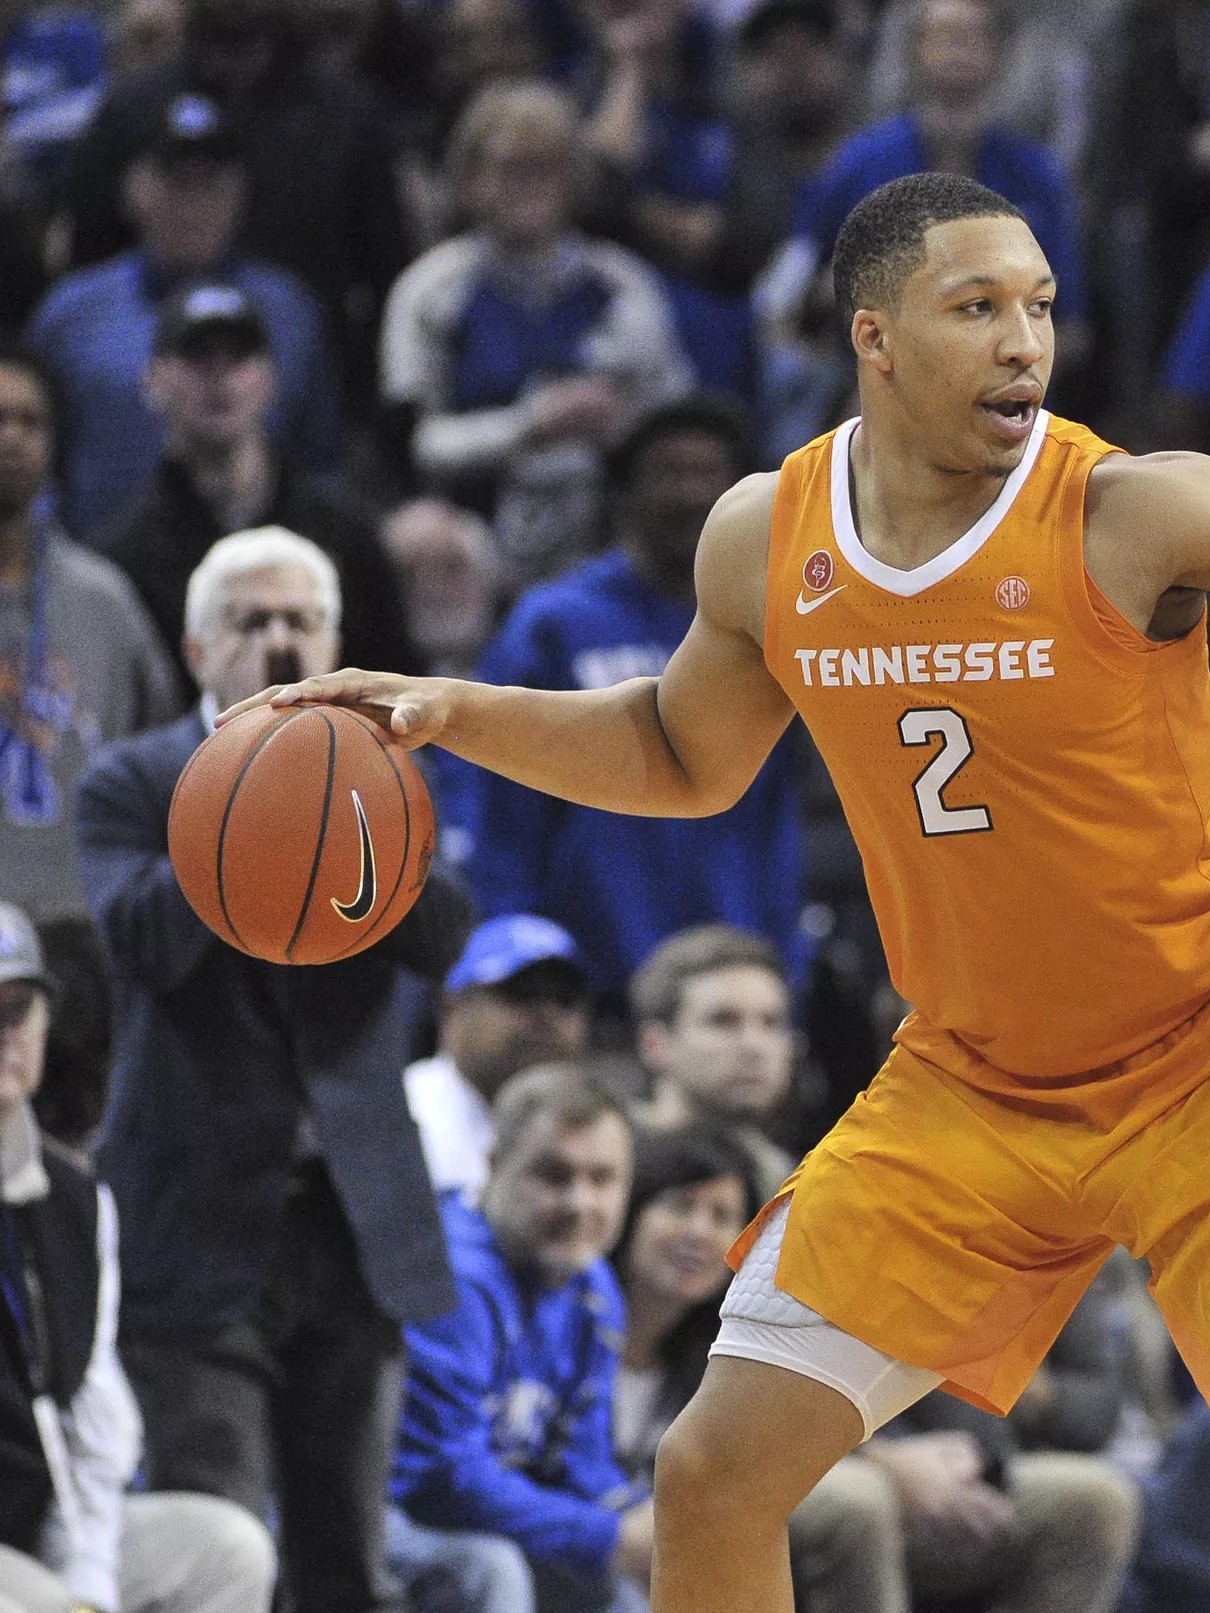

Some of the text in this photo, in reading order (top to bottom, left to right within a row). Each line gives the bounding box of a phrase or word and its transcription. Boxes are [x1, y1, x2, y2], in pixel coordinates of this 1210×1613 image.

[998, 579, 1027, 608] SEC
[794, 638, 1055, 687] TENNESSEE
[897, 706, 994, 837] 2
